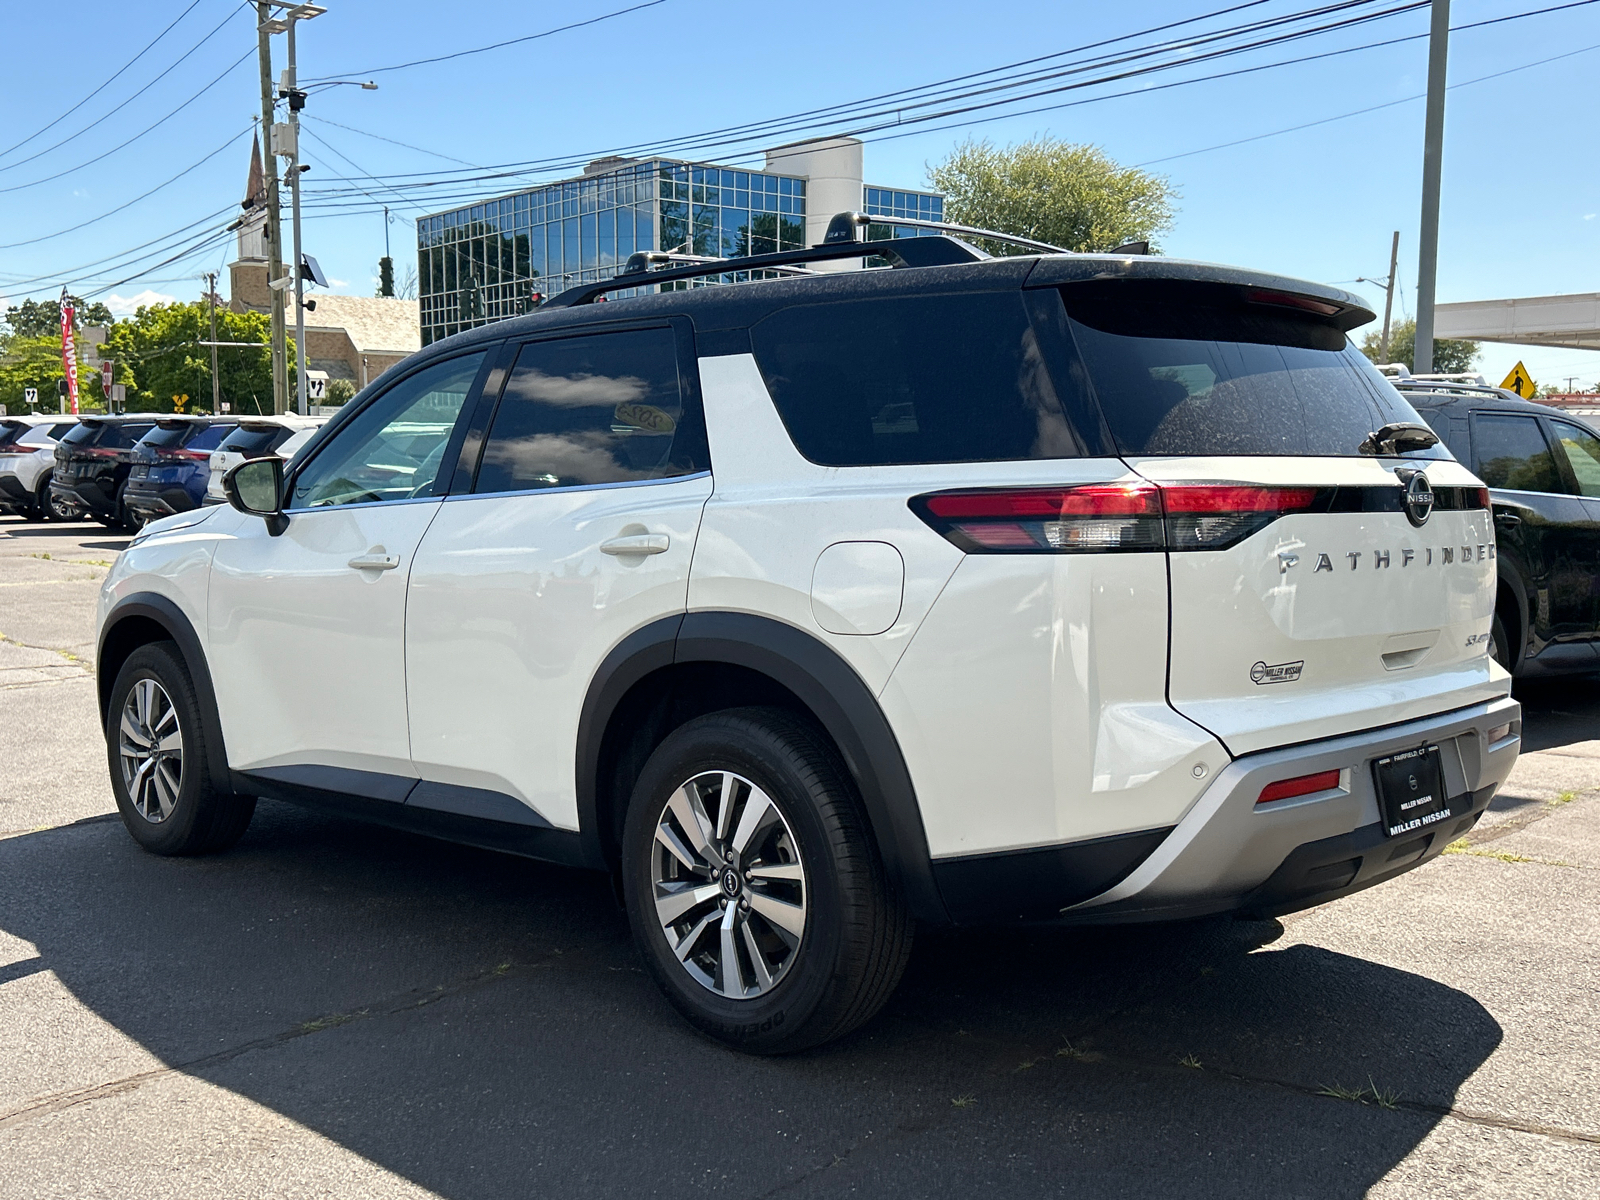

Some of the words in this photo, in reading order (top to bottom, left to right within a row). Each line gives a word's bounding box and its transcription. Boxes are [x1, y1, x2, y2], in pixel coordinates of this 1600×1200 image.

[1400, 800, 1416, 810] MILLER
[1416, 795, 1432, 806] NISSAN
[1390, 818, 1422, 836] MILLER
[1422, 808, 1451, 825] NISSAN
